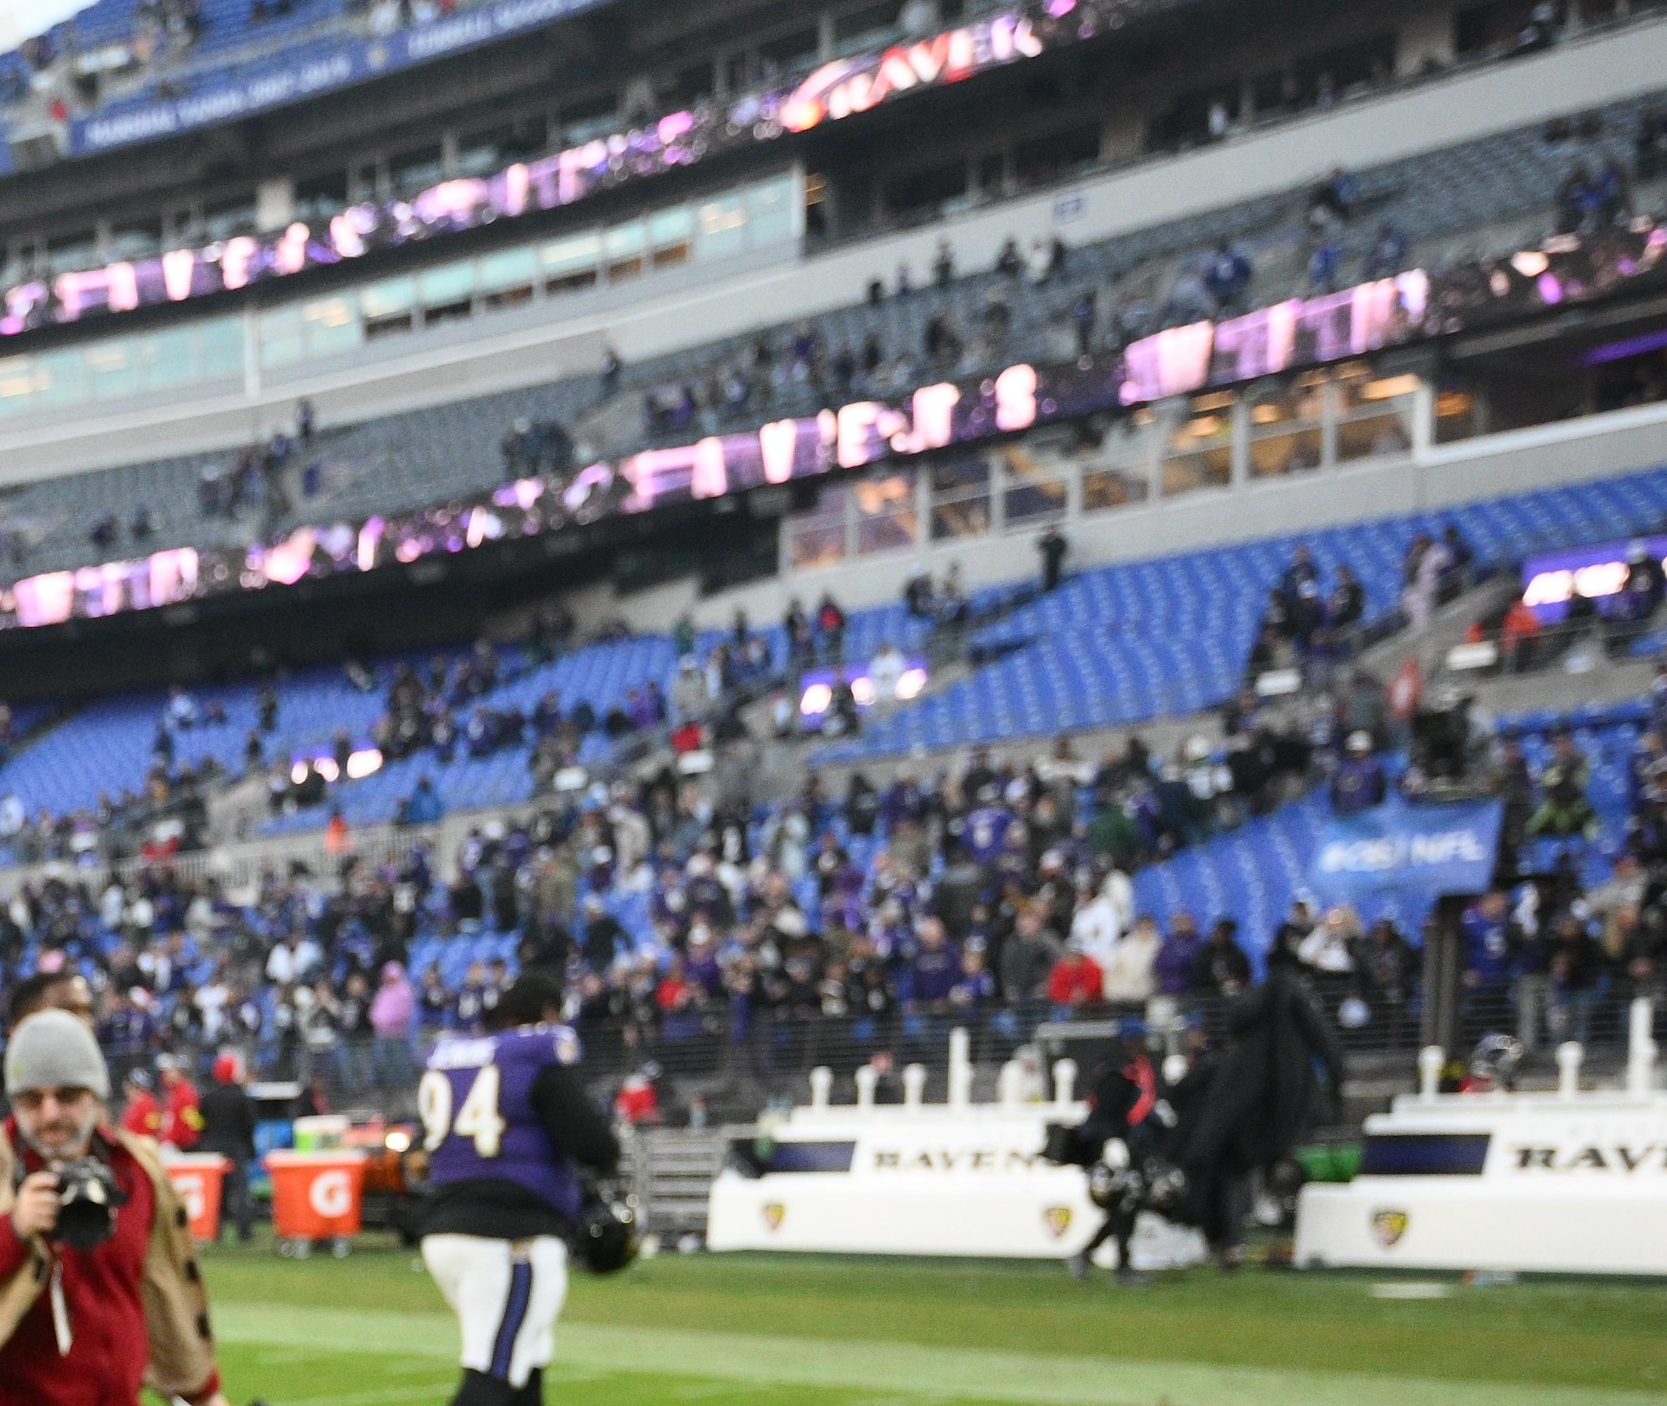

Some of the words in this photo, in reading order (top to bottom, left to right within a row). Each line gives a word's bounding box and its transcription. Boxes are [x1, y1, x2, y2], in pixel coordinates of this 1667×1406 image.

[417, 1063, 507, 1158] 94
[872, 1148, 1045, 1172] RAVEN
[1512, 1146, 1667, 1172] RAV
[308, 1169, 353, 1218] G
